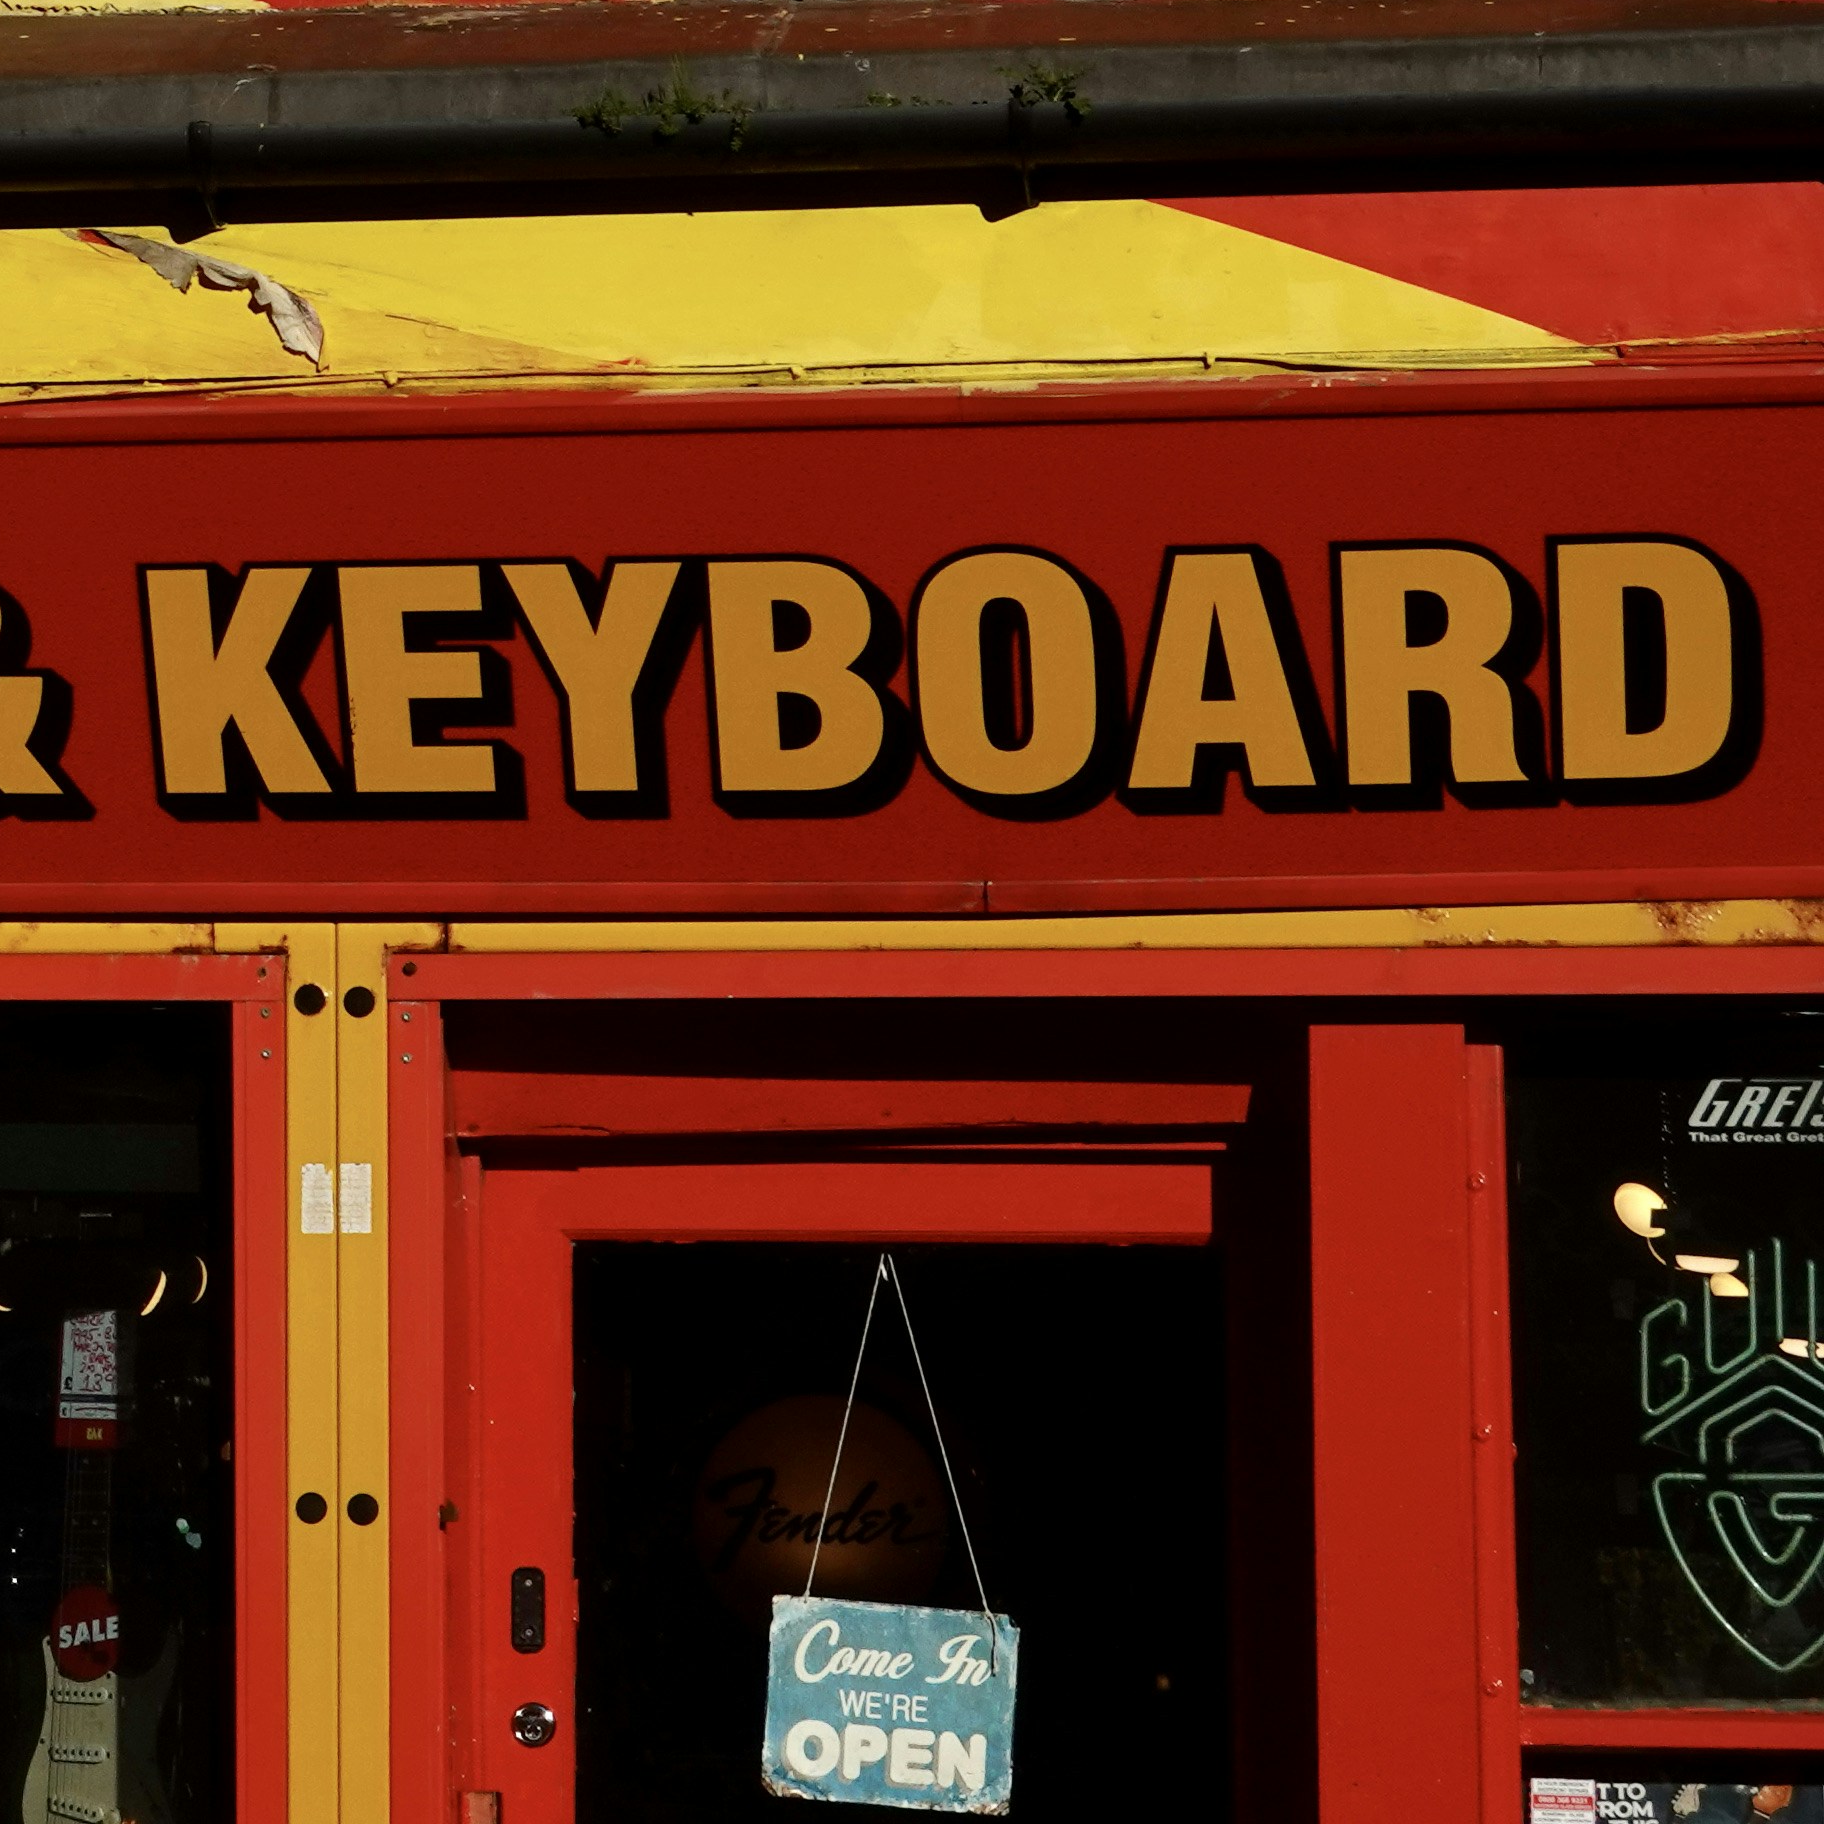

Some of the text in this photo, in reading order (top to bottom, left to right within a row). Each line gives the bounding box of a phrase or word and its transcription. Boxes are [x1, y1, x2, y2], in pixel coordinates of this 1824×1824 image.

[142, 540, 1747, 804] KEYBOARD
[1688, 1131, 1728, 1143] That
[1732, 1131, 1783, 1143] Great
[709, 1466, 945, 1573] Fender
[58, 1615, 120, 1649] SALE
[793, 1618, 992, 1687] Come In
[839, 1688, 929, 1723] WE'RE
[783, 1718, 988, 1792] OPEN
[1612, 1782, 1647, 1801] TO
[1596, 1800, 1655, 1819] ROM
